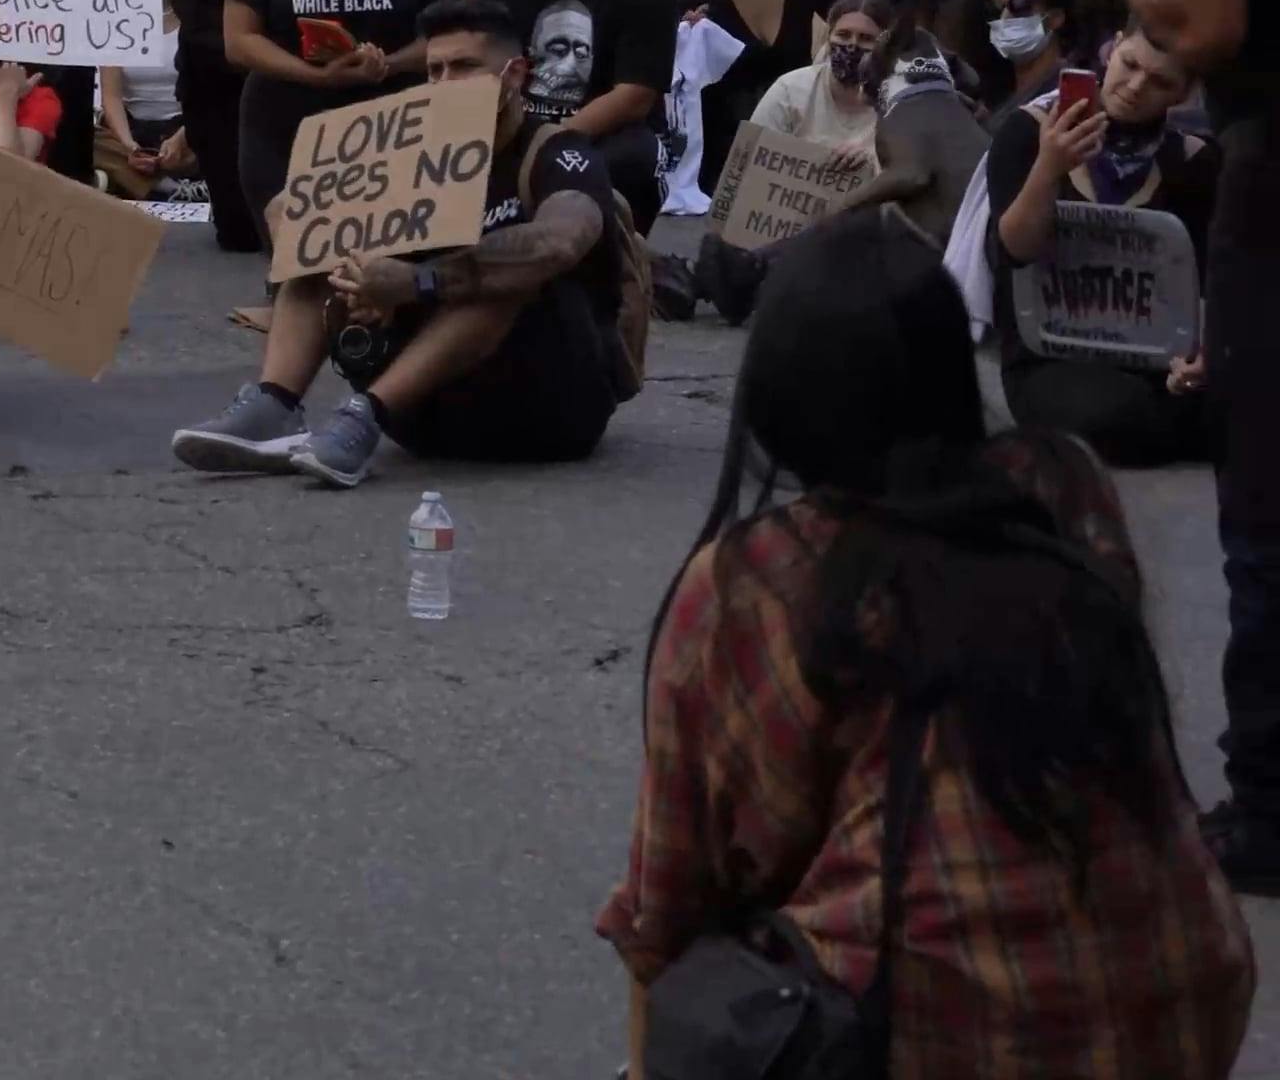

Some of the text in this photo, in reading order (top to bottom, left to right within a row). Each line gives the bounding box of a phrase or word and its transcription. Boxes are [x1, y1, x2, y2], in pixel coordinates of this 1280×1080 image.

[86, 11, 155, 55] US?
[310, 97, 432, 169] LOVE
[412, 139, 490, 190] NO
[752, 145, 864, 194] REMEMBER
[296, 198, 437, 268] COLOR
[744, 209, 804, 240] NAME
[1040, 264, 1155, 324] JUSTICE
